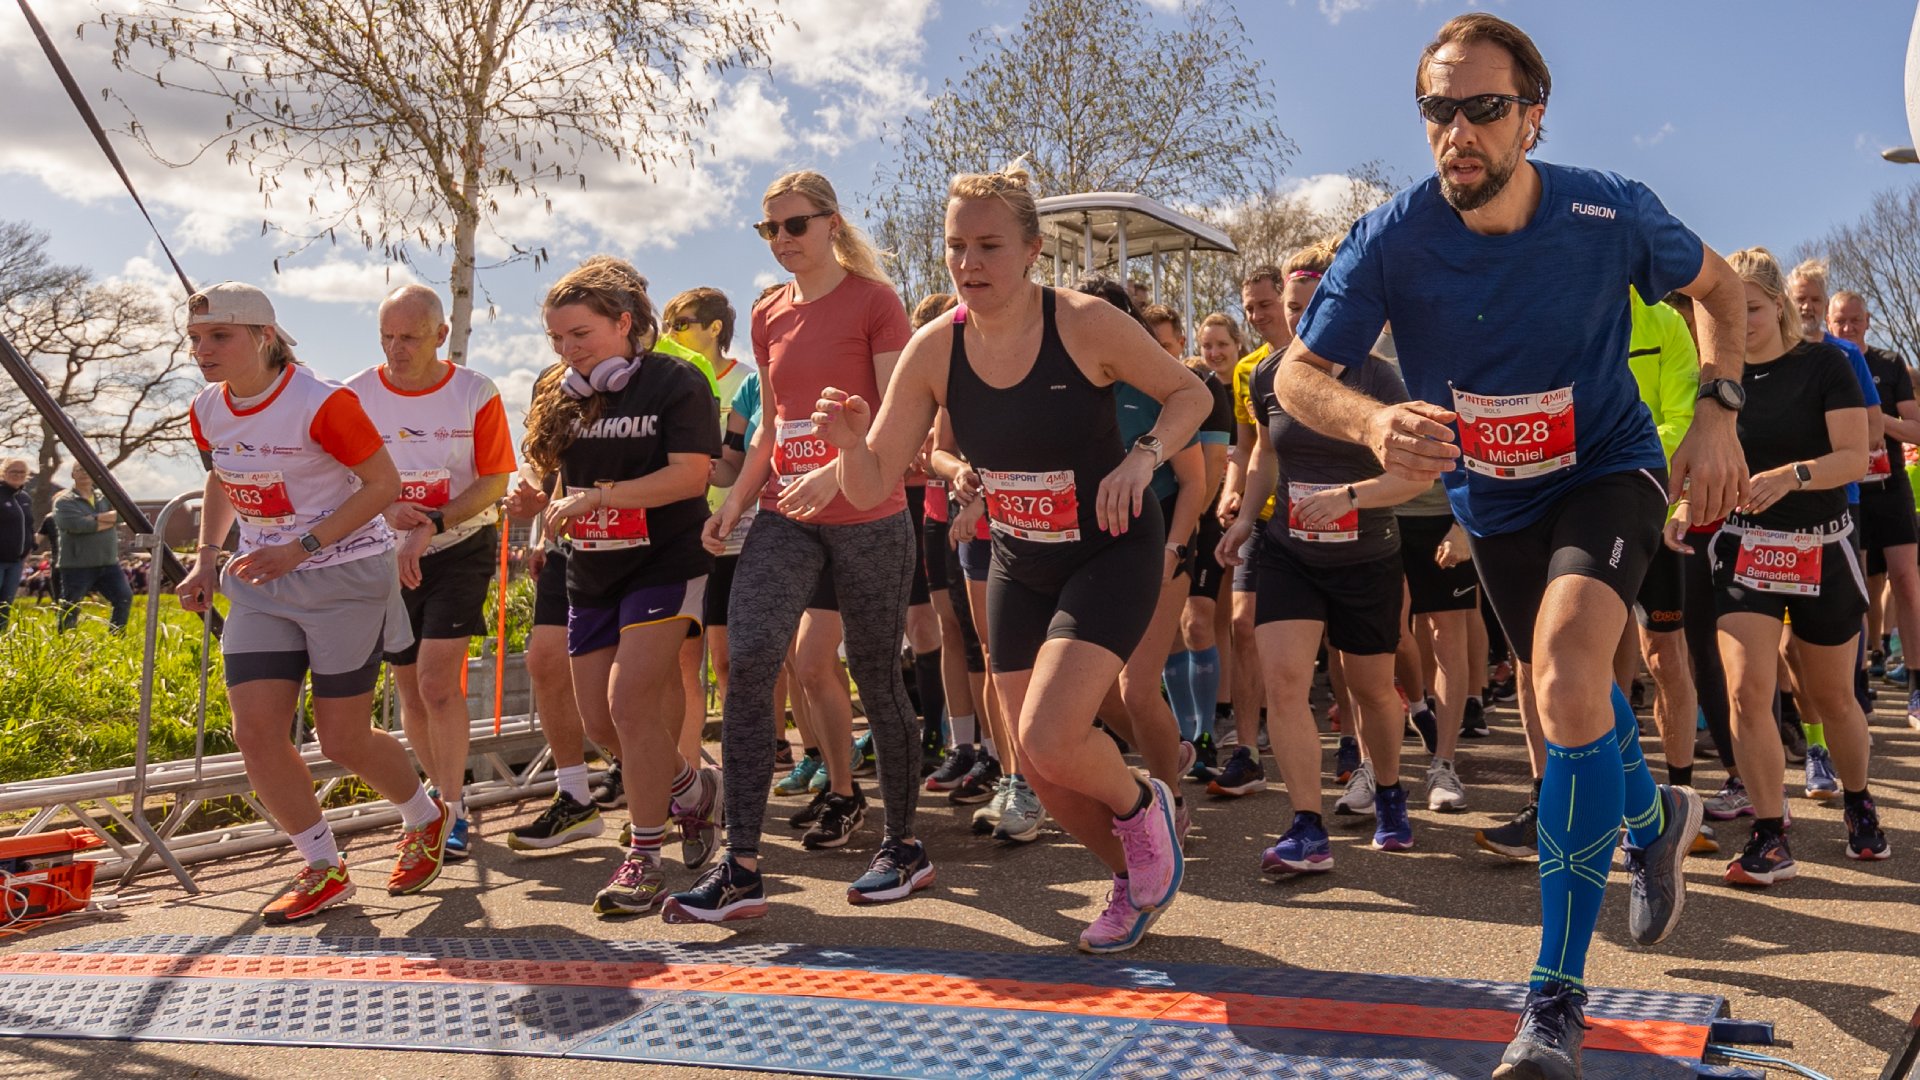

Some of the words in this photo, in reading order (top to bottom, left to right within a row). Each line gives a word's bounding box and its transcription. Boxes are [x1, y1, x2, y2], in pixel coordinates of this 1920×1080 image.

[1571, 202, 1617, 220] FUSION
[1465, 395, 1531, 407] INTERSPORT
[1479, 420, 1550, 446] 3028
[785, 439, 827, 460] 3083
[1488, 447, 1544, 464] Michiel
[792, 462, 820, 473] Tessa
[986, 472, 1038, 483] INTERSPORT
[225, 485, 263, 505] 2163
[999, 493, 1054, 516] 3376
[1008, 513, 1050, 530] Maaike
[586, 528, 609, 539] Irina
[1749, 529, 1788, 540] INTERSPORT
[1609, 536, 1625, 569] FUSION
[1754, 548, 1797, 569] 3089
[1746, 565, 1801, 582] Bernadette
[1549, 746, 1601, 760] STOX
